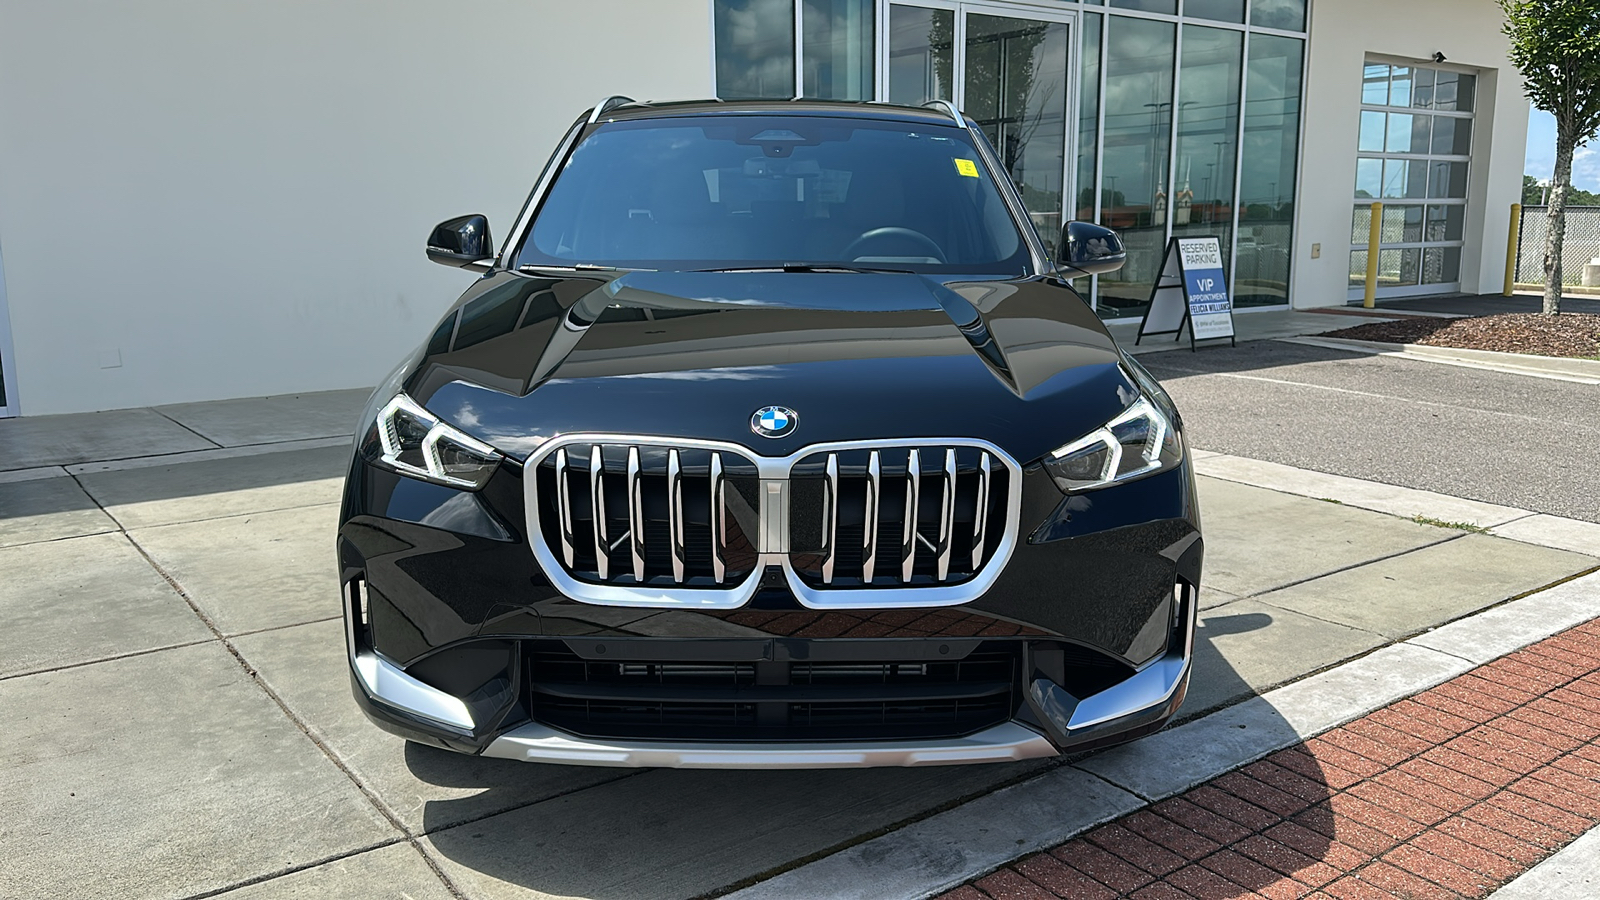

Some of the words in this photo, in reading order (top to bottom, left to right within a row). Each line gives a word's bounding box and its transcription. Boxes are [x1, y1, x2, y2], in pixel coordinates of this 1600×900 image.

[1181, 243, 1217, 253] RESERVED
[1186, 254, 1217, 264] PARKING
[1197, 279, 1213, 291] VIP
[1190, 293, 1226, 302] APPOINTMENT
